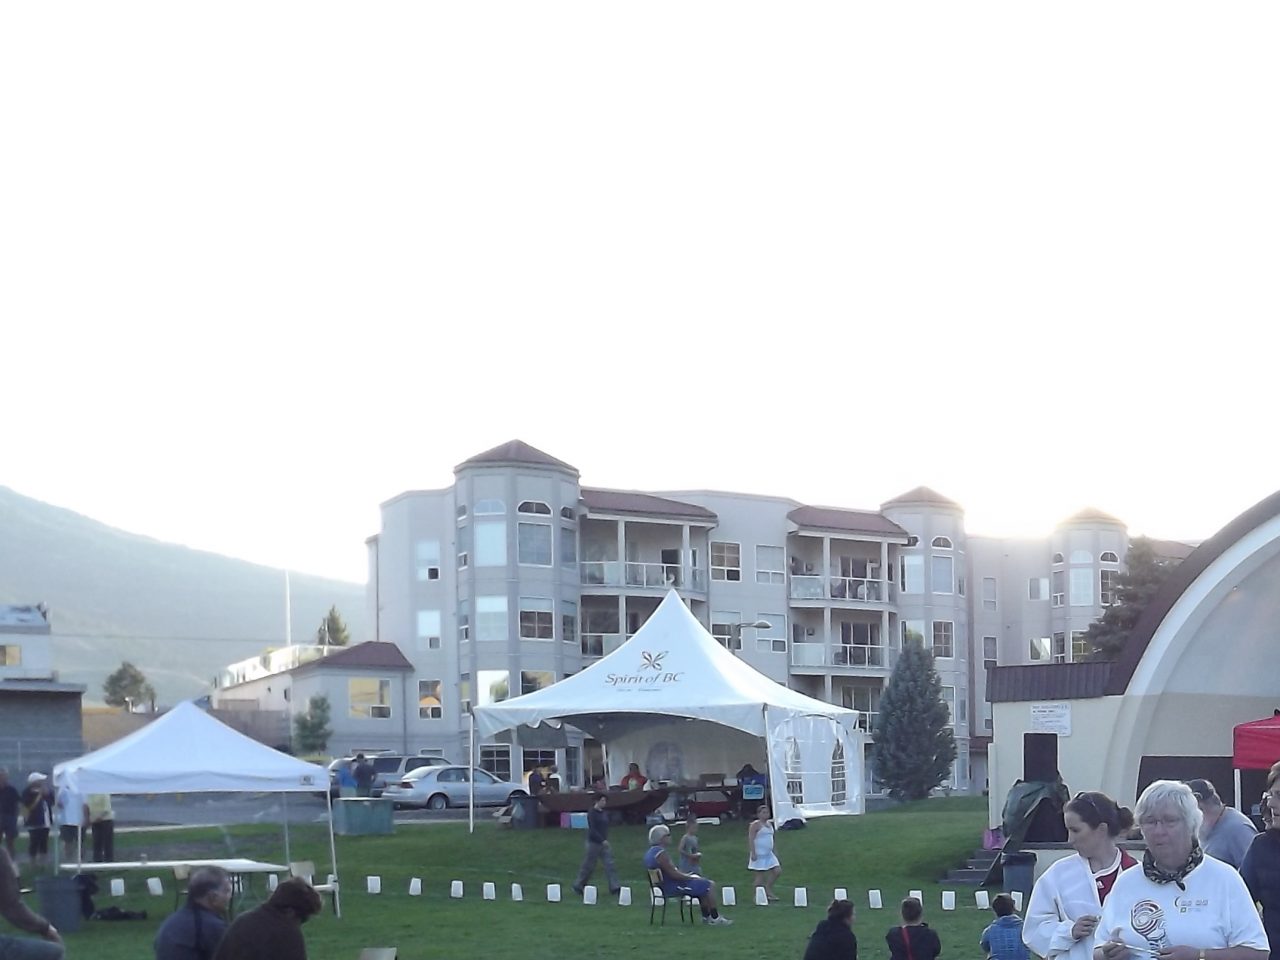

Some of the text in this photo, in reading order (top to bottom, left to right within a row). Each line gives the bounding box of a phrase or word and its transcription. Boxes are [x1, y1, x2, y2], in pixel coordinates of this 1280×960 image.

[605, 672, 683, 686] Spirit of BC
